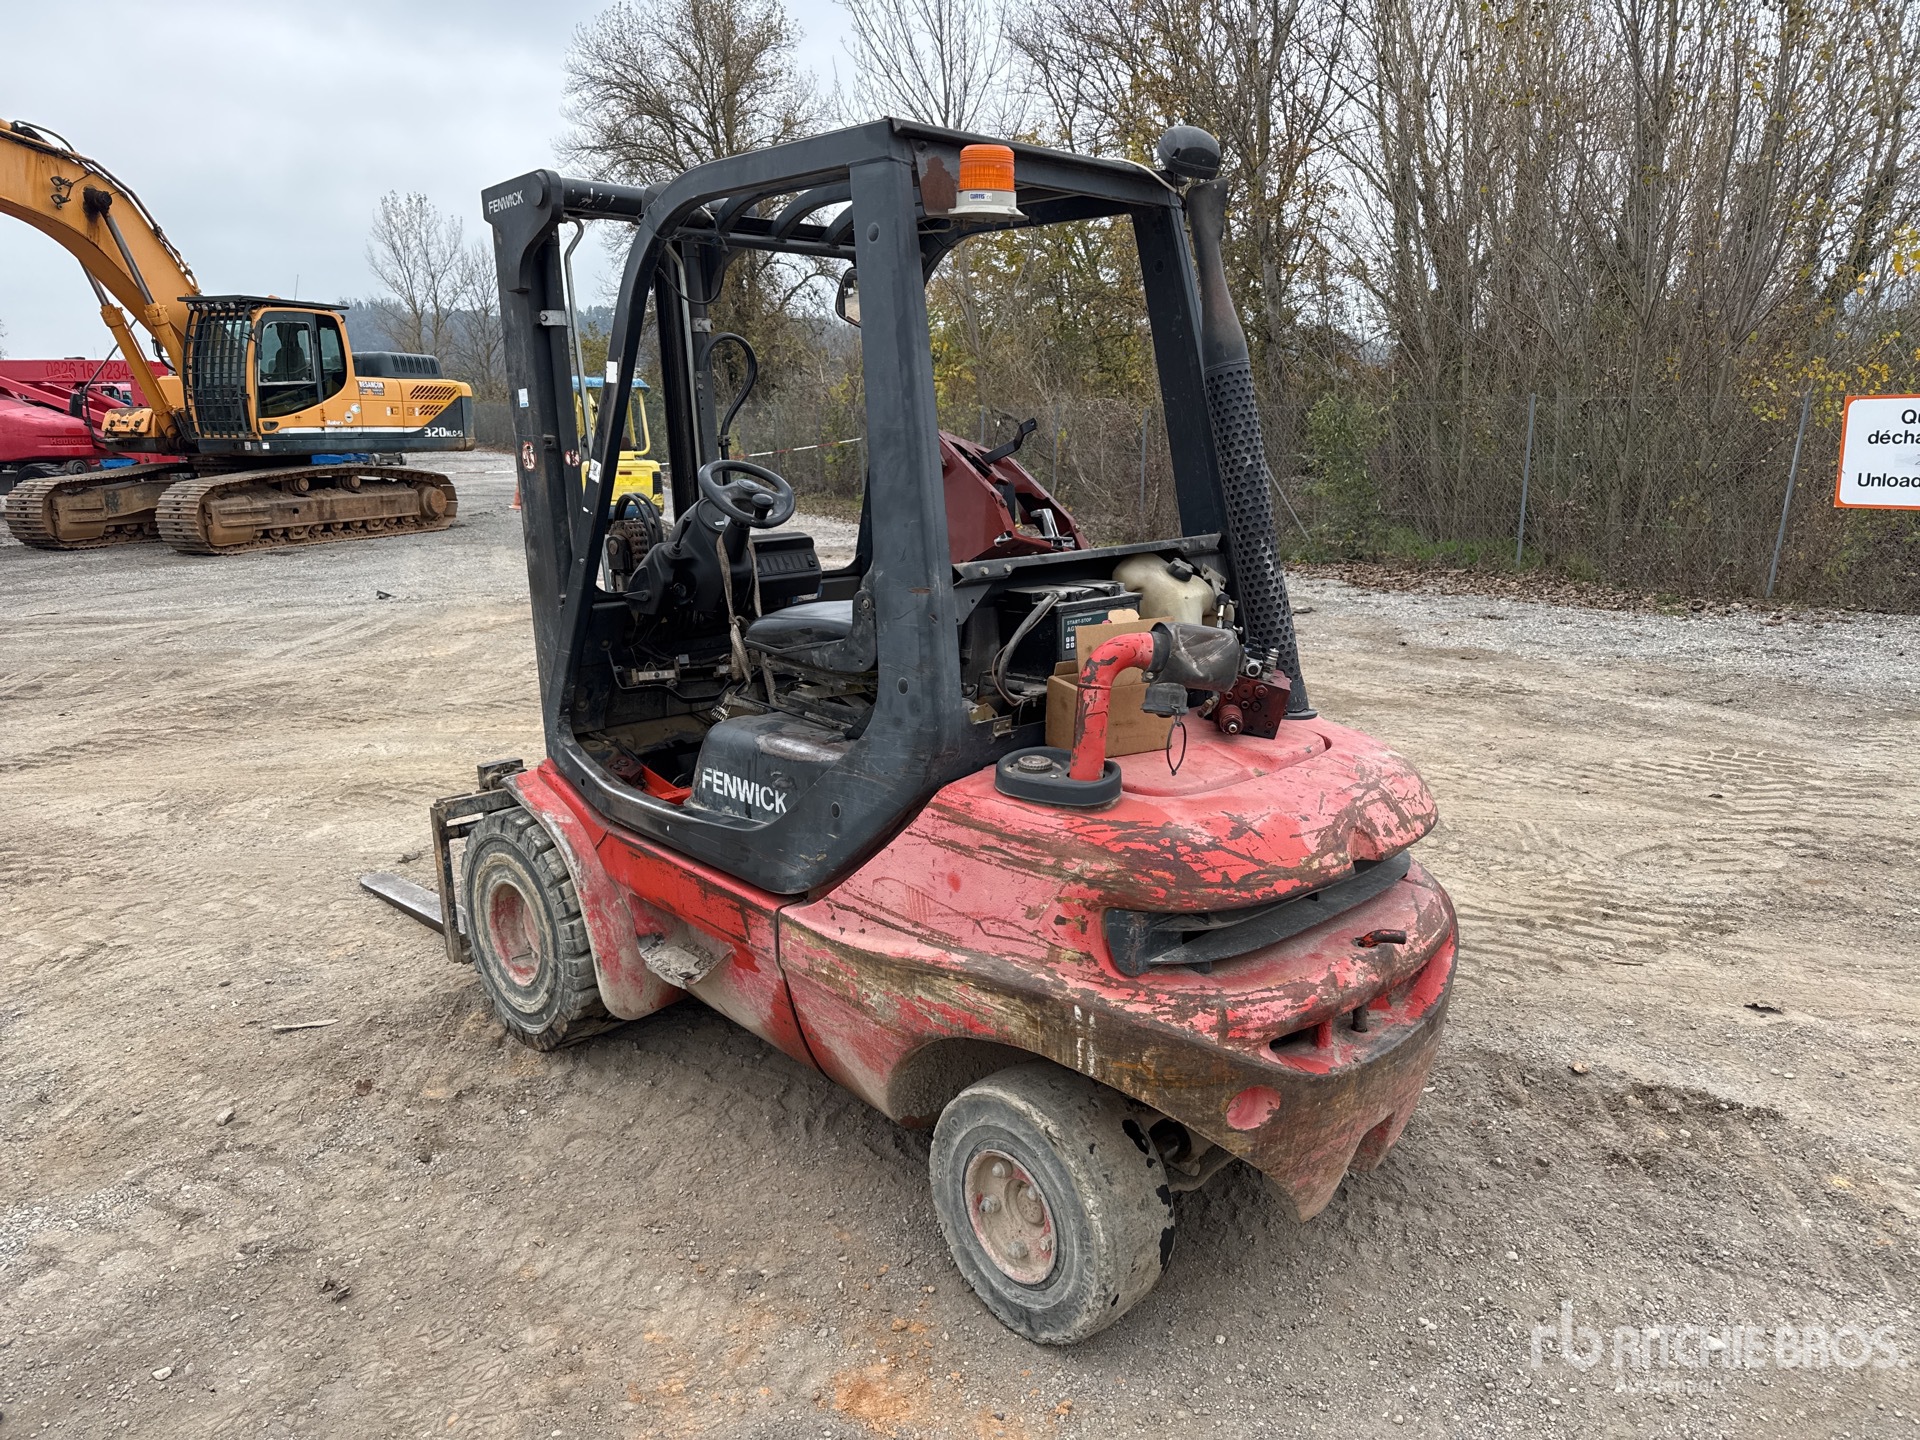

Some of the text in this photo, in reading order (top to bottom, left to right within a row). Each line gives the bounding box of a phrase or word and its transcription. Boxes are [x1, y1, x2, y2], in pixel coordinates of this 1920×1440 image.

[488, 189, 524, 215] FENWICK
[46, 362, 77, 379] 0826
[80, 362, 95, 379] 16
[1901, 409, 1920, 424] Q
[1857, 472, 1920, 488] Unload
[702, 768, 787, 813] FENWICK
